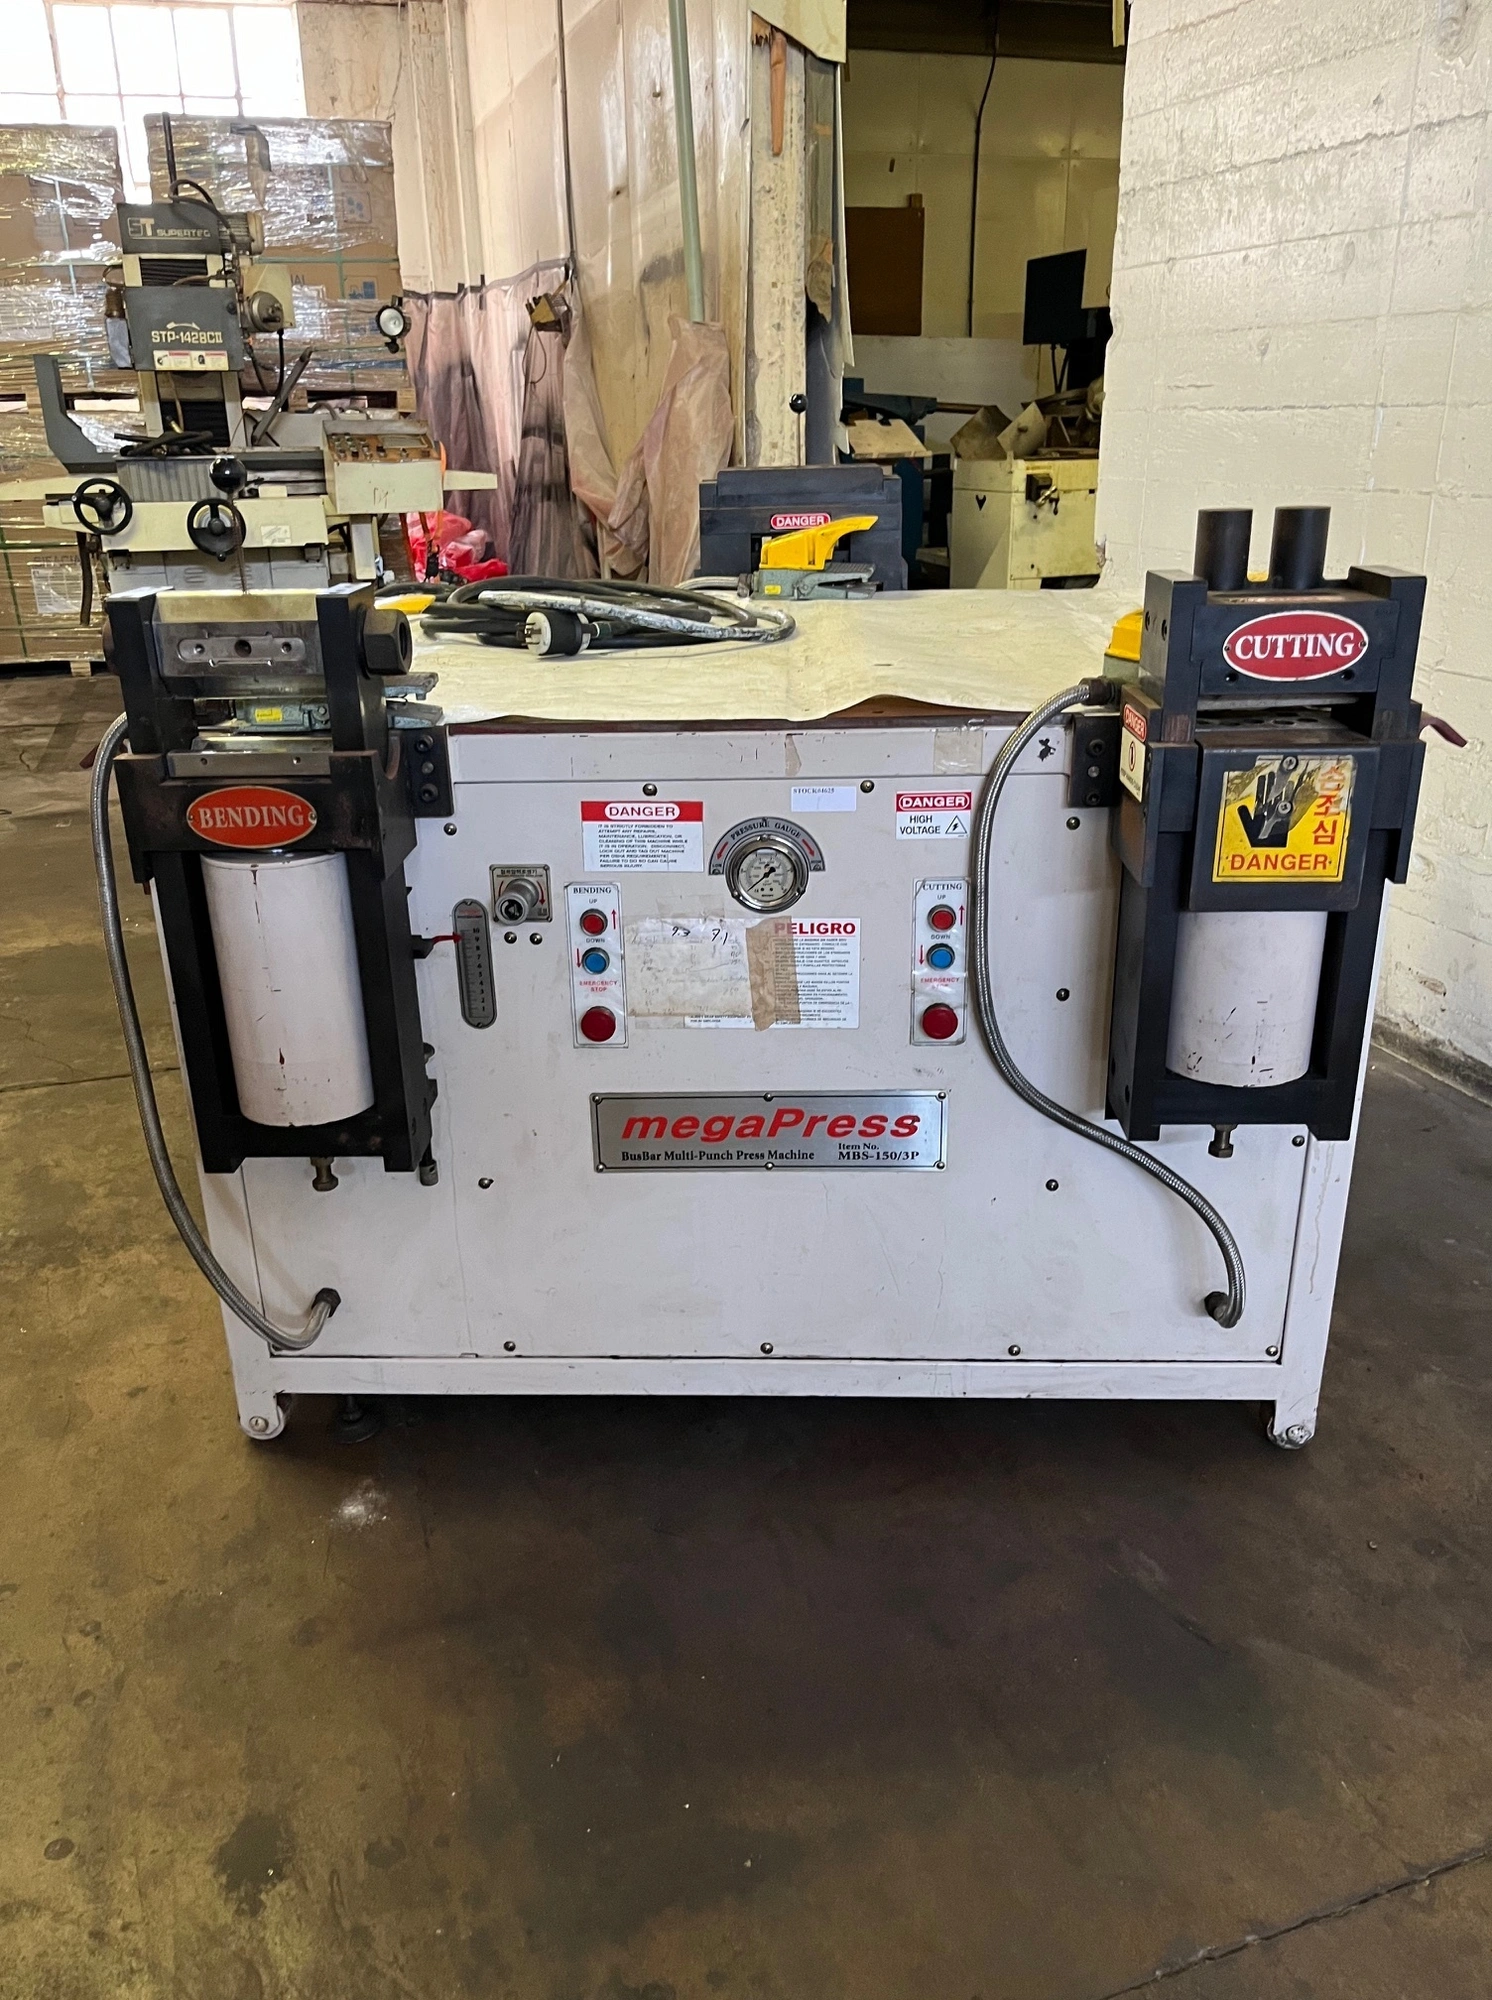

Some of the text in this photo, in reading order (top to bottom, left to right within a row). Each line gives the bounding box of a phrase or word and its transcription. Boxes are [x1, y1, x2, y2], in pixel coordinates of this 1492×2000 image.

[776, 515, 825, 528] DANGER
[1234, 631, 1355, 660] CUTTING
[1125, 706, 1145, 739] DANGER
[902, 796, 966, 808] DANGER
[198, 804, 304, 829] BENDING
[609, 806, 676, 817] DANGER
[909, 814, 933, 824] HIGH
[730, 820, 801, 840] PRESSURE GAUGE
[899, 825, 941, 835] VOLTAGE
[1230, 854, 1329, 871] DANGER
[573, 886, 612, 894] BENDING
[922, 883, 963, 891] CUTTING
[774, 922, 856, 935] PELIGRO
[621, 1108, 921, 1143] megaPress
[838, 1142, 880, 1150] Item No.
[621, 1149, 815, 1161] BusBar Multi-Punch Press Machine
[838, 1151, 920, 1161] MBS-150/3P
